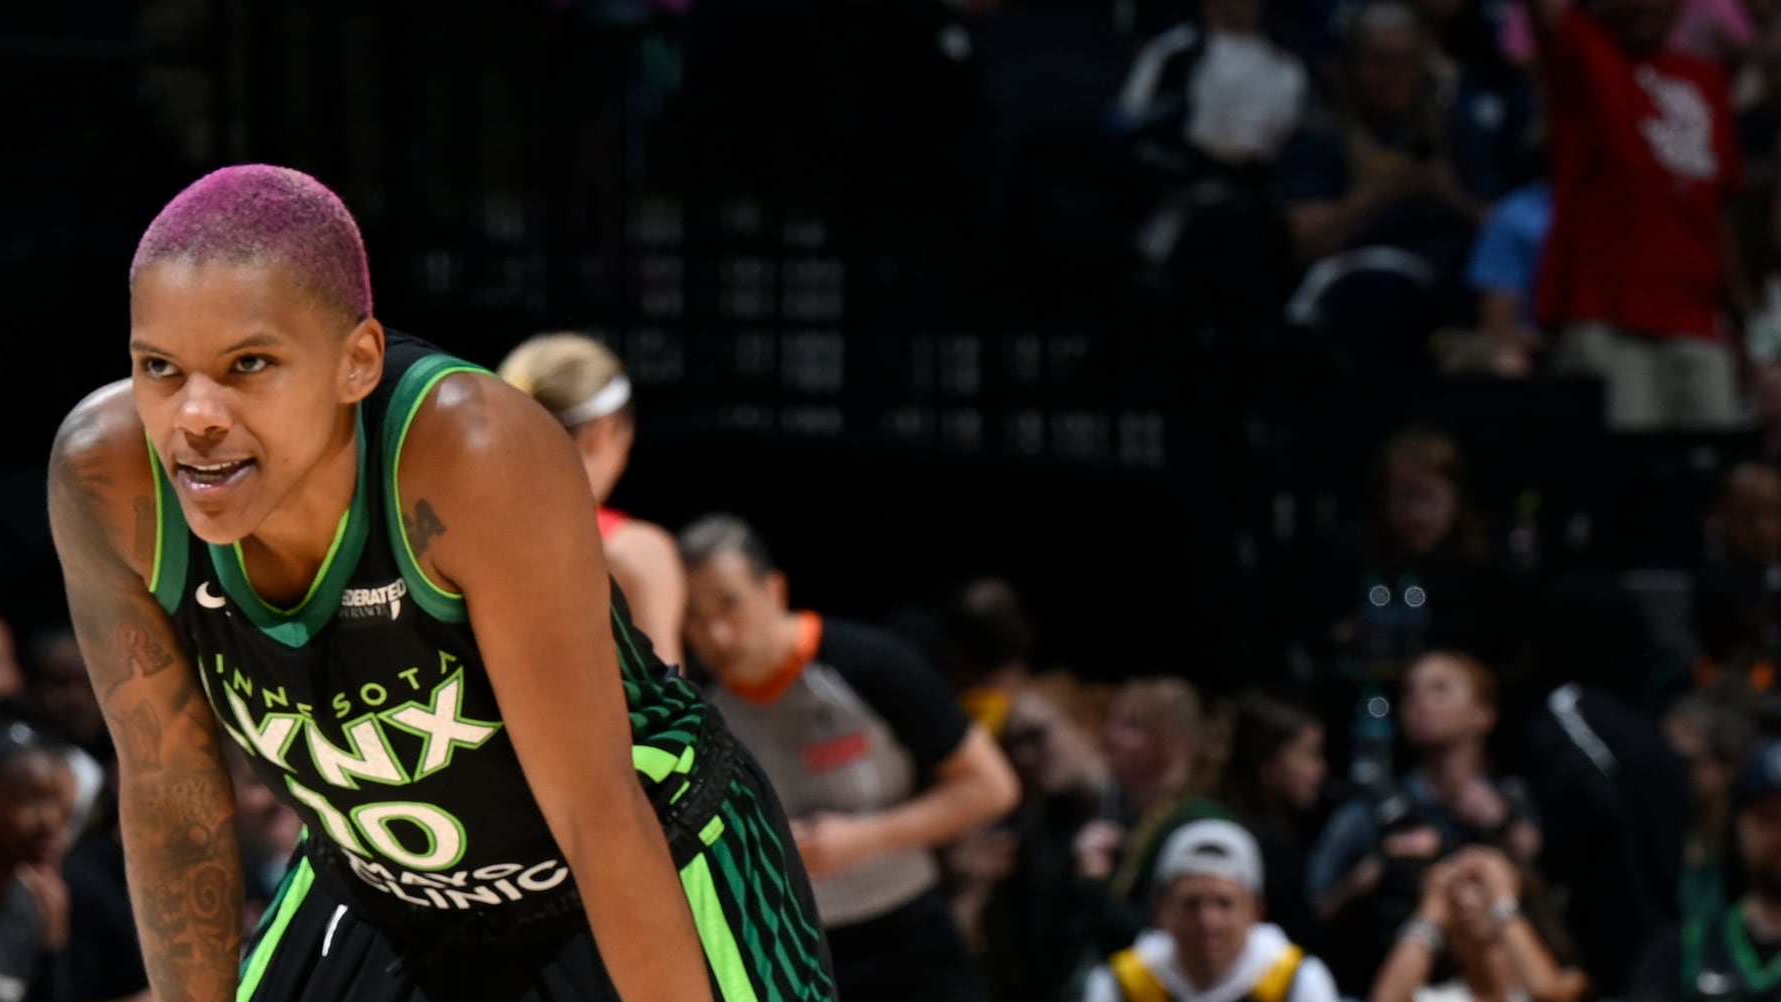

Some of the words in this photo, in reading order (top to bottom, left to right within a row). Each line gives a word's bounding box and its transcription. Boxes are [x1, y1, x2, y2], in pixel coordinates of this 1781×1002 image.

[198, 655, 504, 790] YNX
[284, 774, 467, 872] 10
[349, 859, 569, 909] CLINIC
